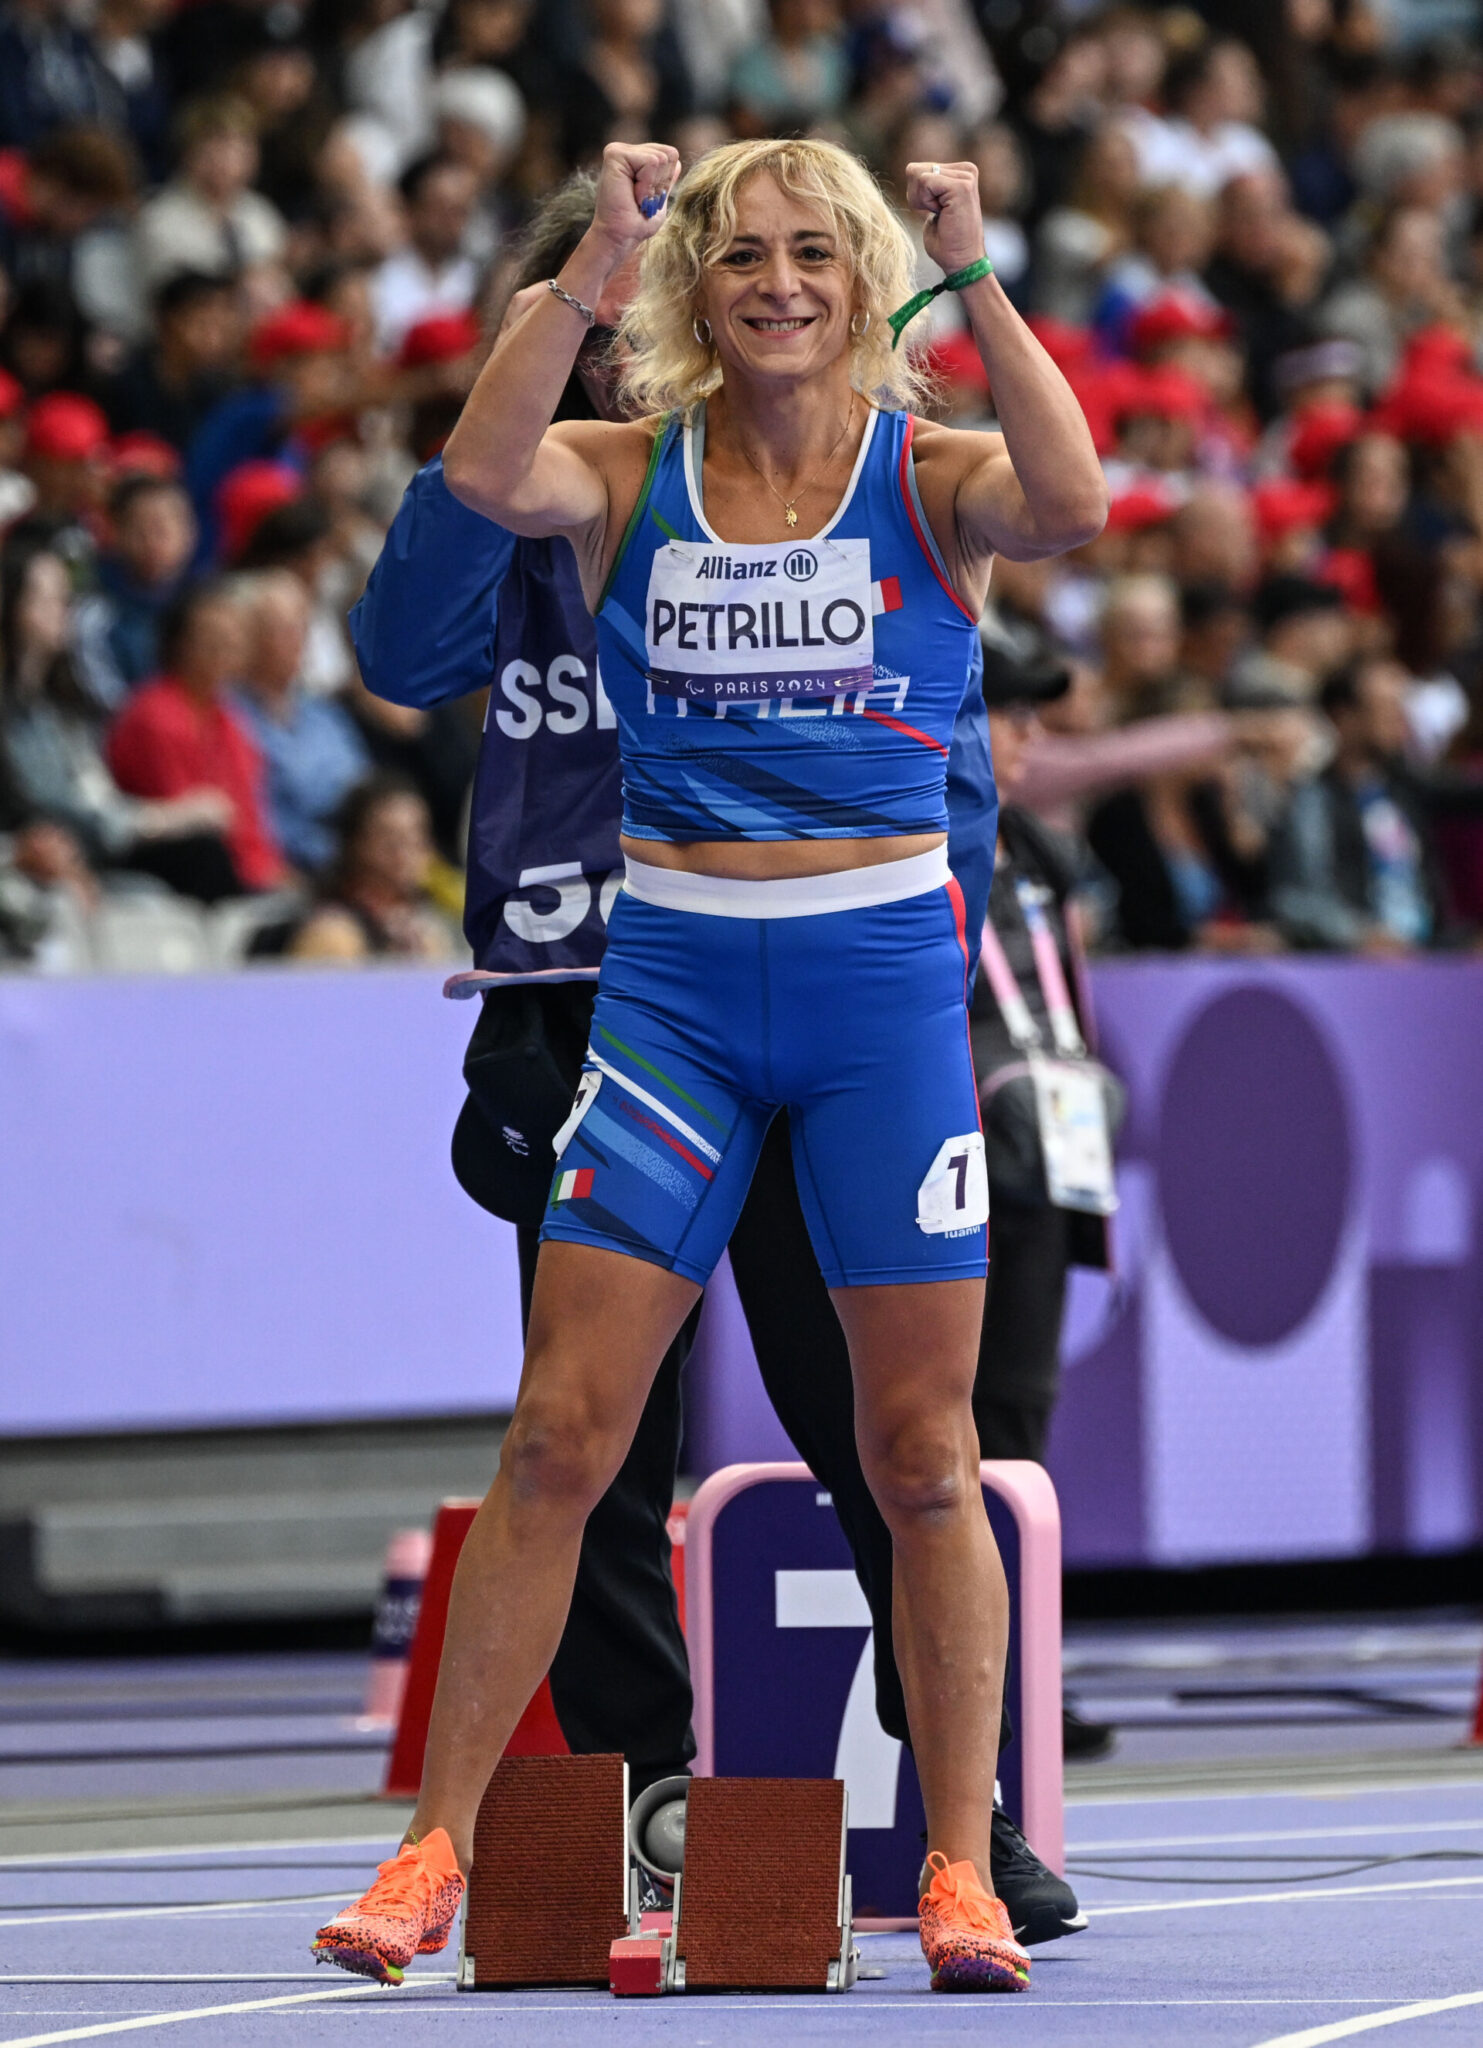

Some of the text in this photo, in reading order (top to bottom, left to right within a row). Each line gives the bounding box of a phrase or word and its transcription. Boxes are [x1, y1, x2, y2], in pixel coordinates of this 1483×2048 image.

[696, 556, 777, 580] Allianz
[652, 598, 866, 651] PETRILLO
[714, 678, 826, 695] PARIS 2024
[776, 1570, 903, 1828] 7
